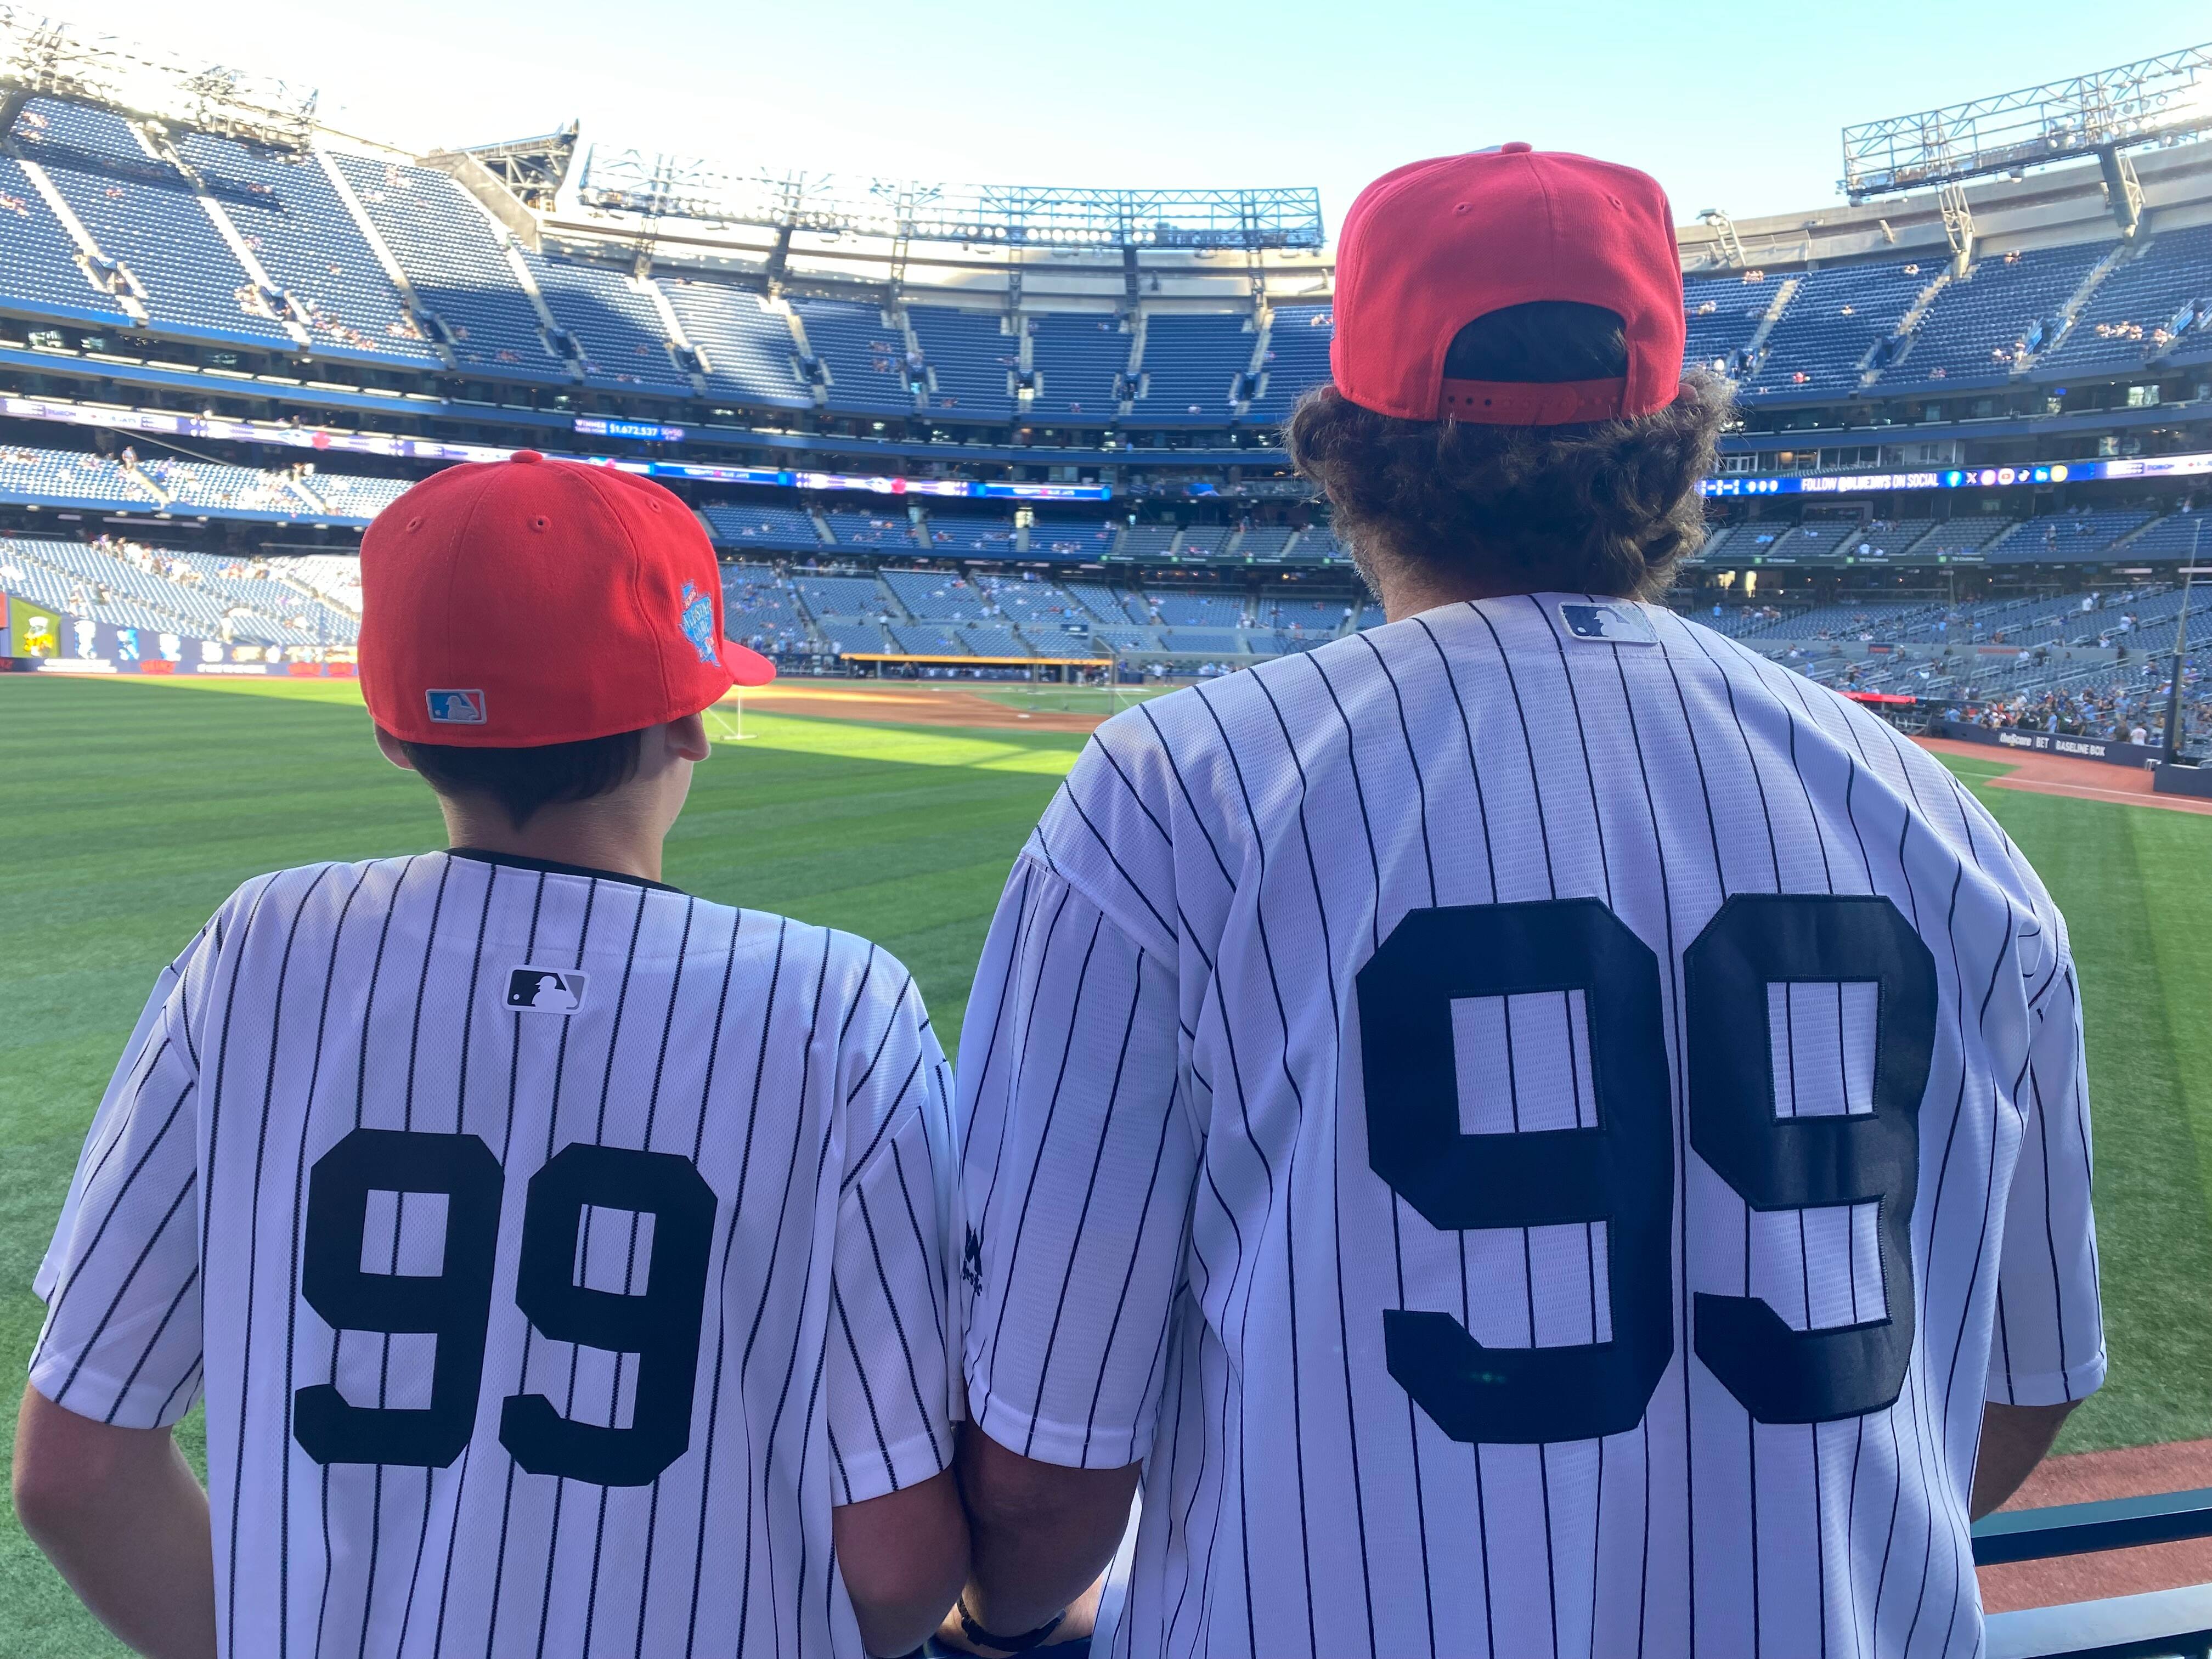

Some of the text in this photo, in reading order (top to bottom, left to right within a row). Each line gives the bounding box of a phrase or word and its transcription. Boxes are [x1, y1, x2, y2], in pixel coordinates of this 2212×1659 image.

[1802, 477, 1836, 492] FOLLOW
[1893, 474, 1906, 489] ON
[1906, 472, 1940, 488] SOCIAL
[2000, 732, 2106, 757] theScore BET BASELINE BOX
[1356, 893, 1939, 1444] 99
[294, 1127, 718, 1487] 99
